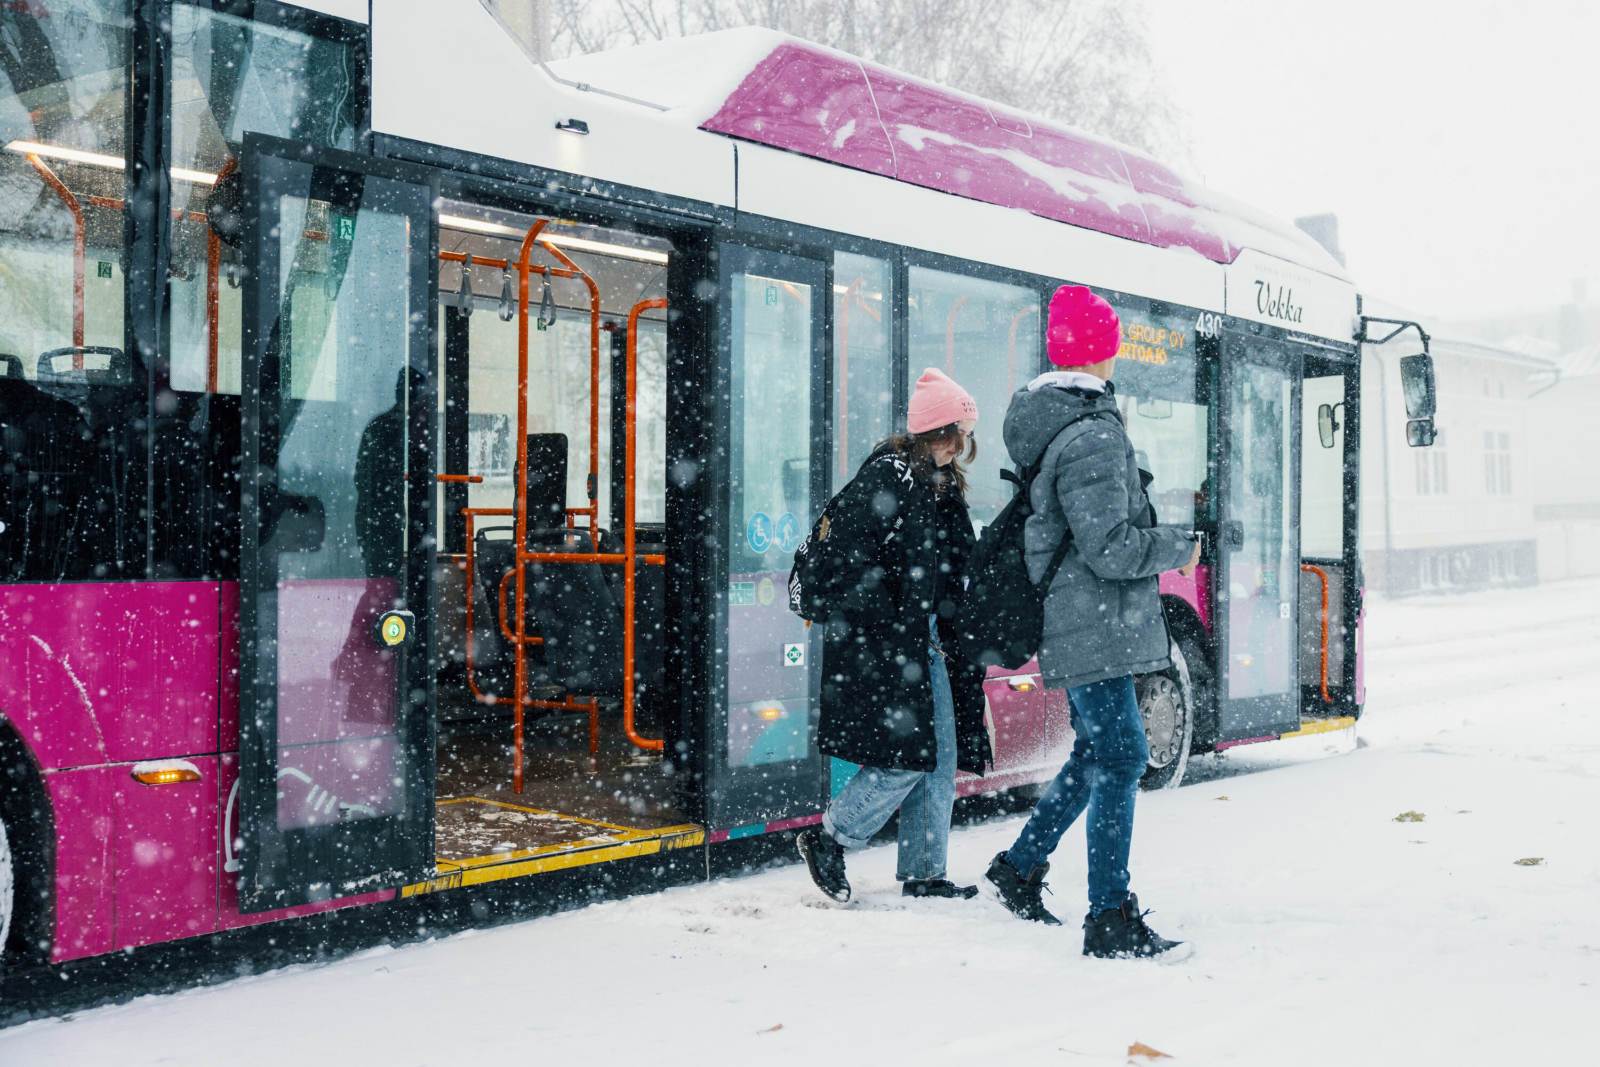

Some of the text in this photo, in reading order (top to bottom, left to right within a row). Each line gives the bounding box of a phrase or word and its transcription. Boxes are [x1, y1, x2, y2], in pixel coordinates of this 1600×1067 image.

[1254, 280, 1303, 323] Vekka
[1128, 323, 1166, 345] GROUP
[1169, 331, 1186, 349] OY
[789, 650, 800, 659] CNG
